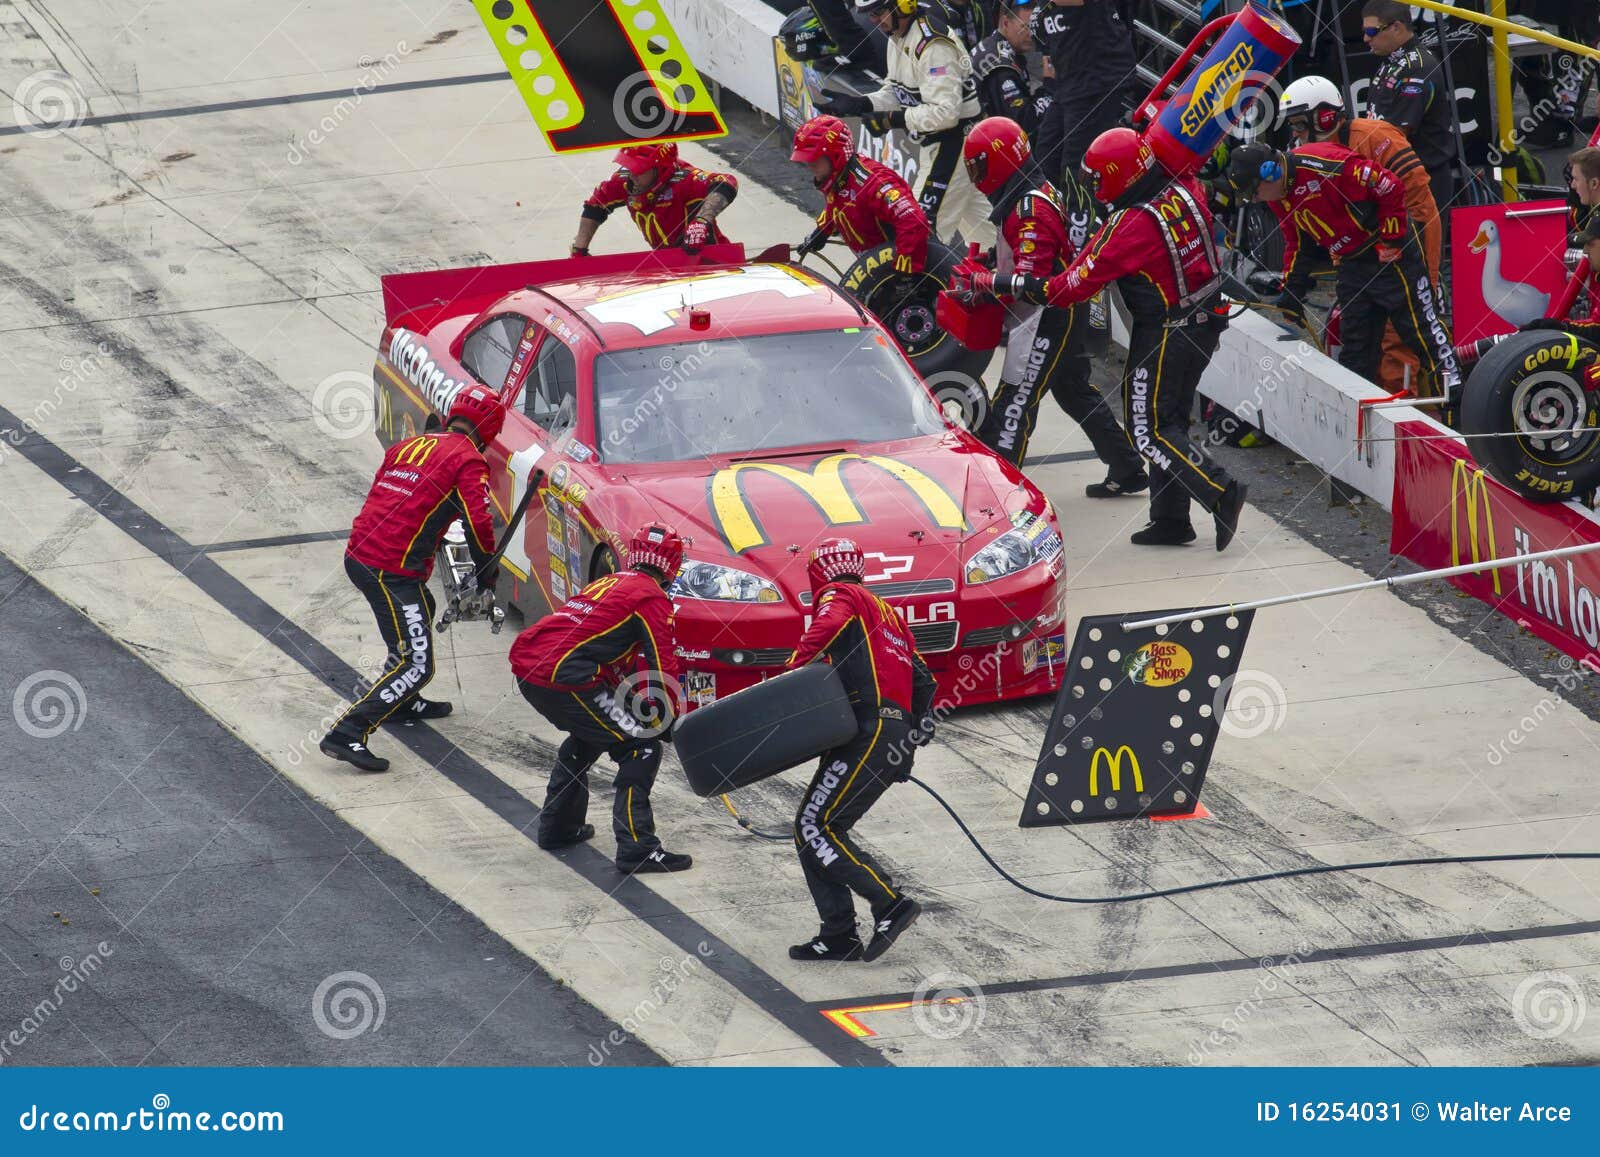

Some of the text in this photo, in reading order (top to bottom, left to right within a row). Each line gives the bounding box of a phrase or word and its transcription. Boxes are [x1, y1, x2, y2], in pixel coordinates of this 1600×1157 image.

[1184, 47, 1251, 134] SUNOCO
[389, 327, 465, 416] McDonal
[998, 335, 1050, 450] McDonald's
[1515, 469, 1574, 493] EAGLE
[1150, 643, 1177, 656] Bass
[1152, 657, 1172, 668] Pro
[1152, 667, 1186, 680] Shops
[688, 675, 714, 691] WIX
[800, 759, 848, 867] McDonald's
